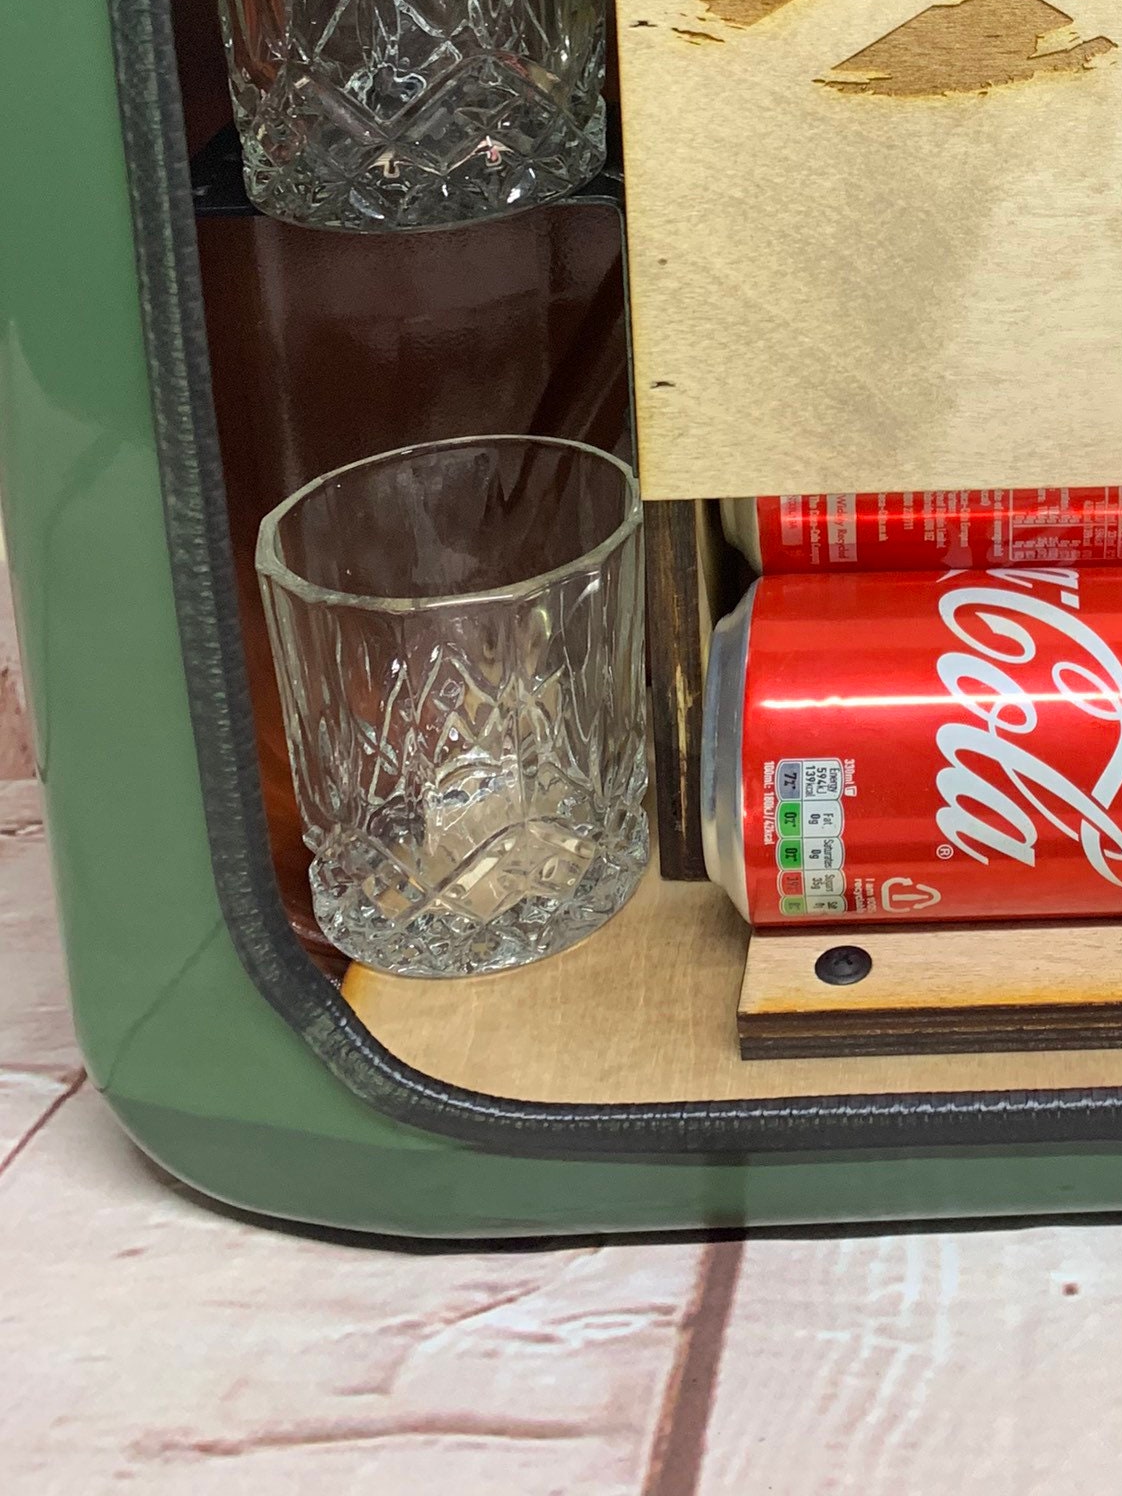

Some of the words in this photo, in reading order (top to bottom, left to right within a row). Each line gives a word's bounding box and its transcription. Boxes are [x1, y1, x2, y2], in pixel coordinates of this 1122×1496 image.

[844, 759, 855, 784] 330ml
[829, 768, 840, 792] Energy
[808, 813, 821, 825] 0g
[823, 813, 834, 825] Fat
[809, 849, 822, 859] 0g
